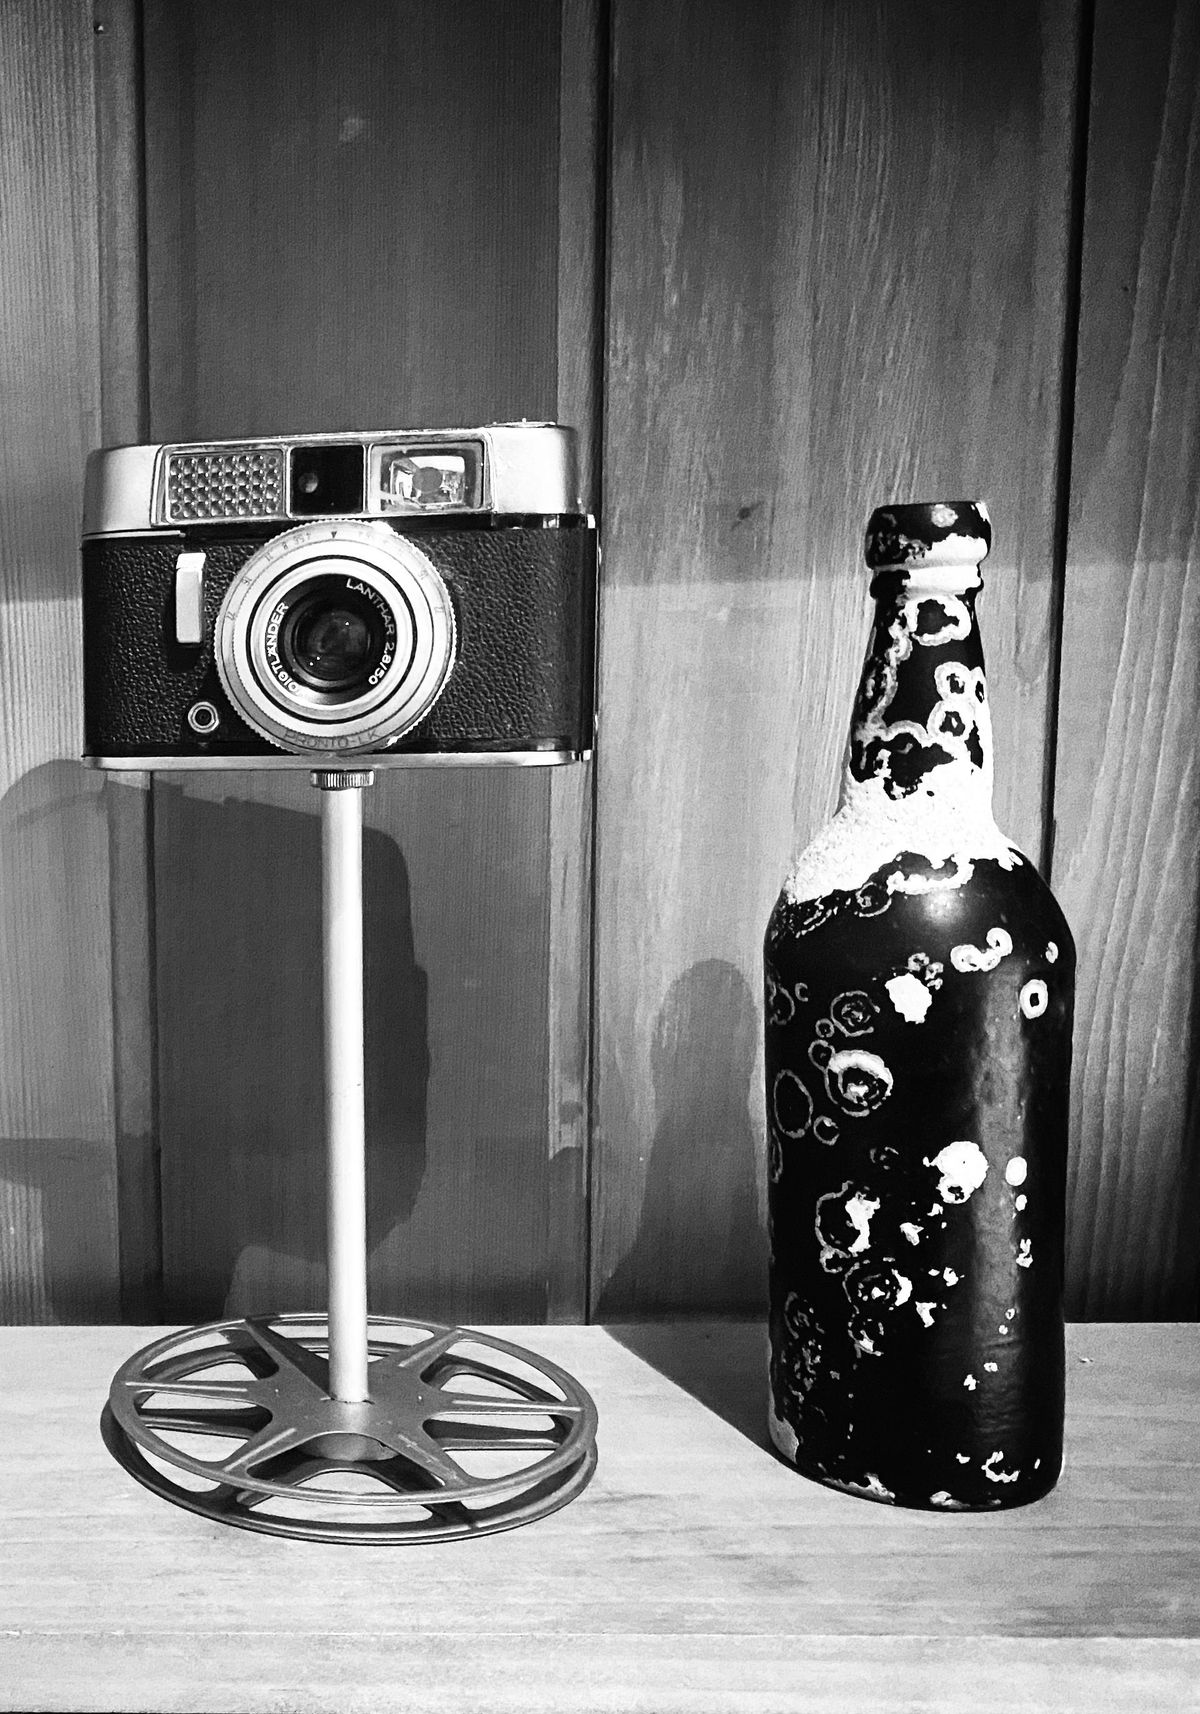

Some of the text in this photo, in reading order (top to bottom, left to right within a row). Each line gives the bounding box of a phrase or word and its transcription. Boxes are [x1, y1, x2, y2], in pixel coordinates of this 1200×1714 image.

[346, 577, 395, 635] LANTHAR
[266, 601, 299, 695] OIGTLÄNDER
[368, 641, 395, 686] 2.8/50
